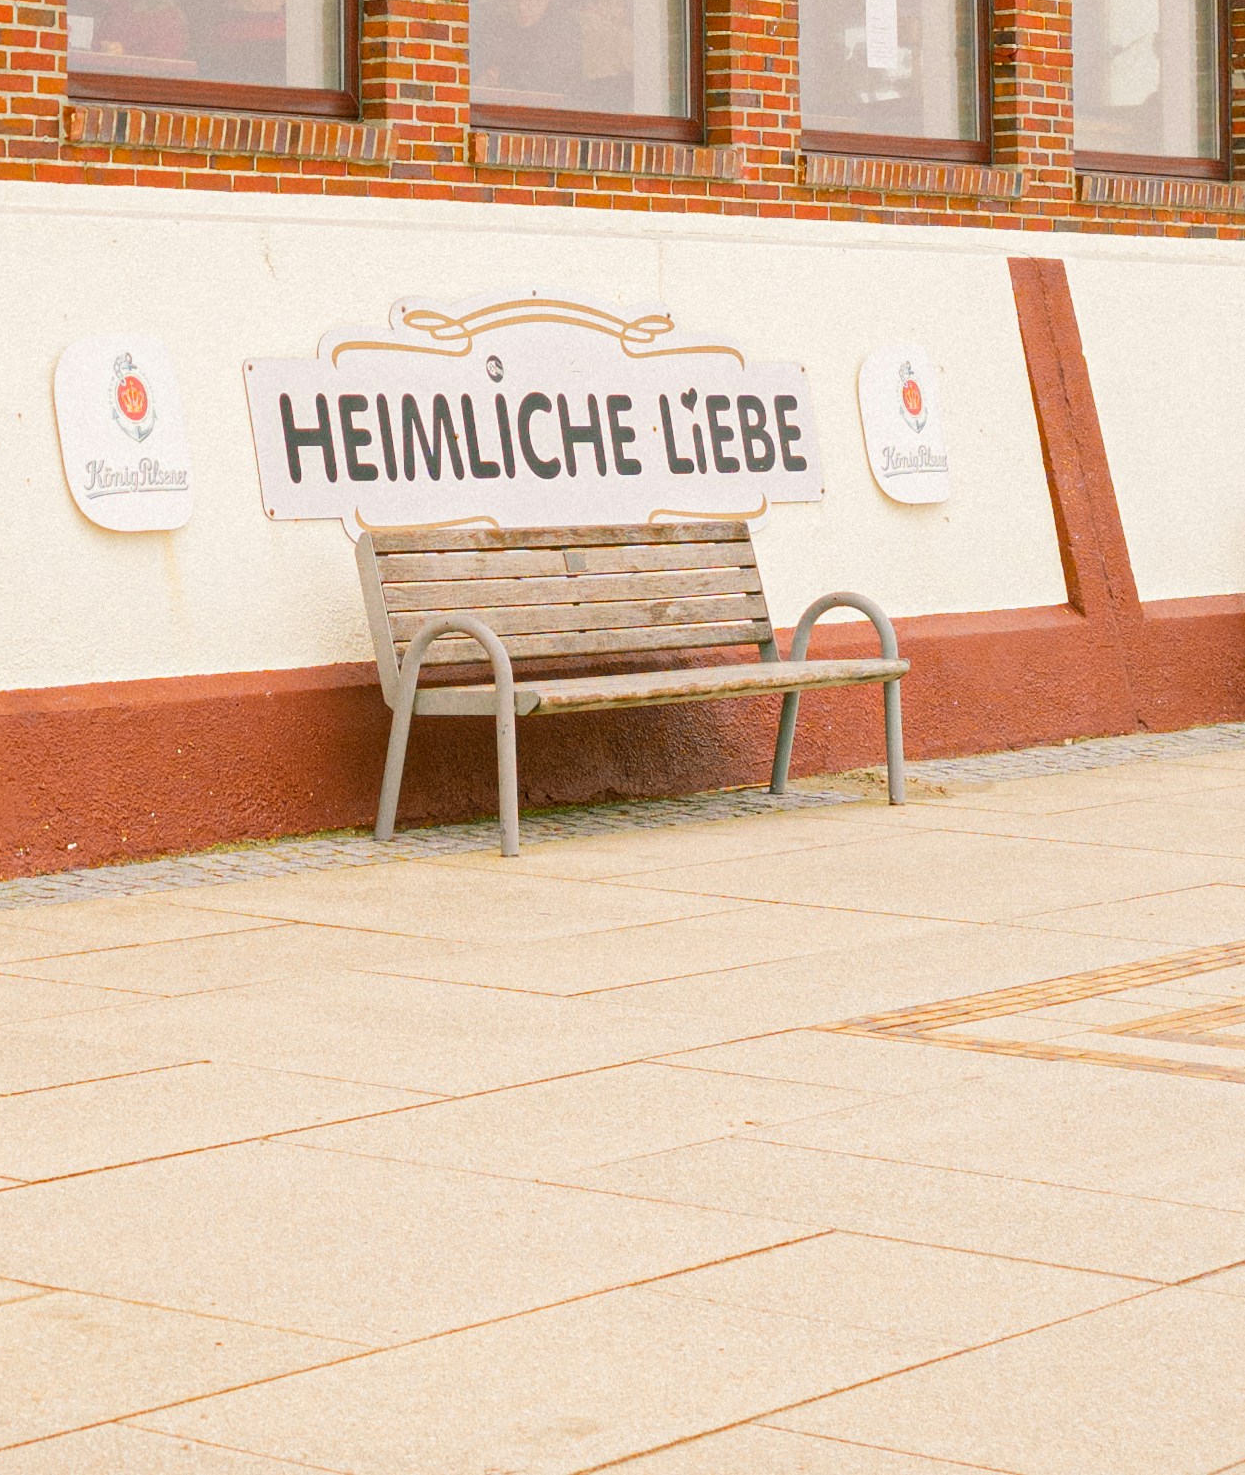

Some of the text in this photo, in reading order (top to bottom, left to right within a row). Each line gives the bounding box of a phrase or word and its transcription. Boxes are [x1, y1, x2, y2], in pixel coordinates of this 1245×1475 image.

[279, 392, 642, 484] HEIMLICHE
[84, 457, 188, 492] König Pilsener
